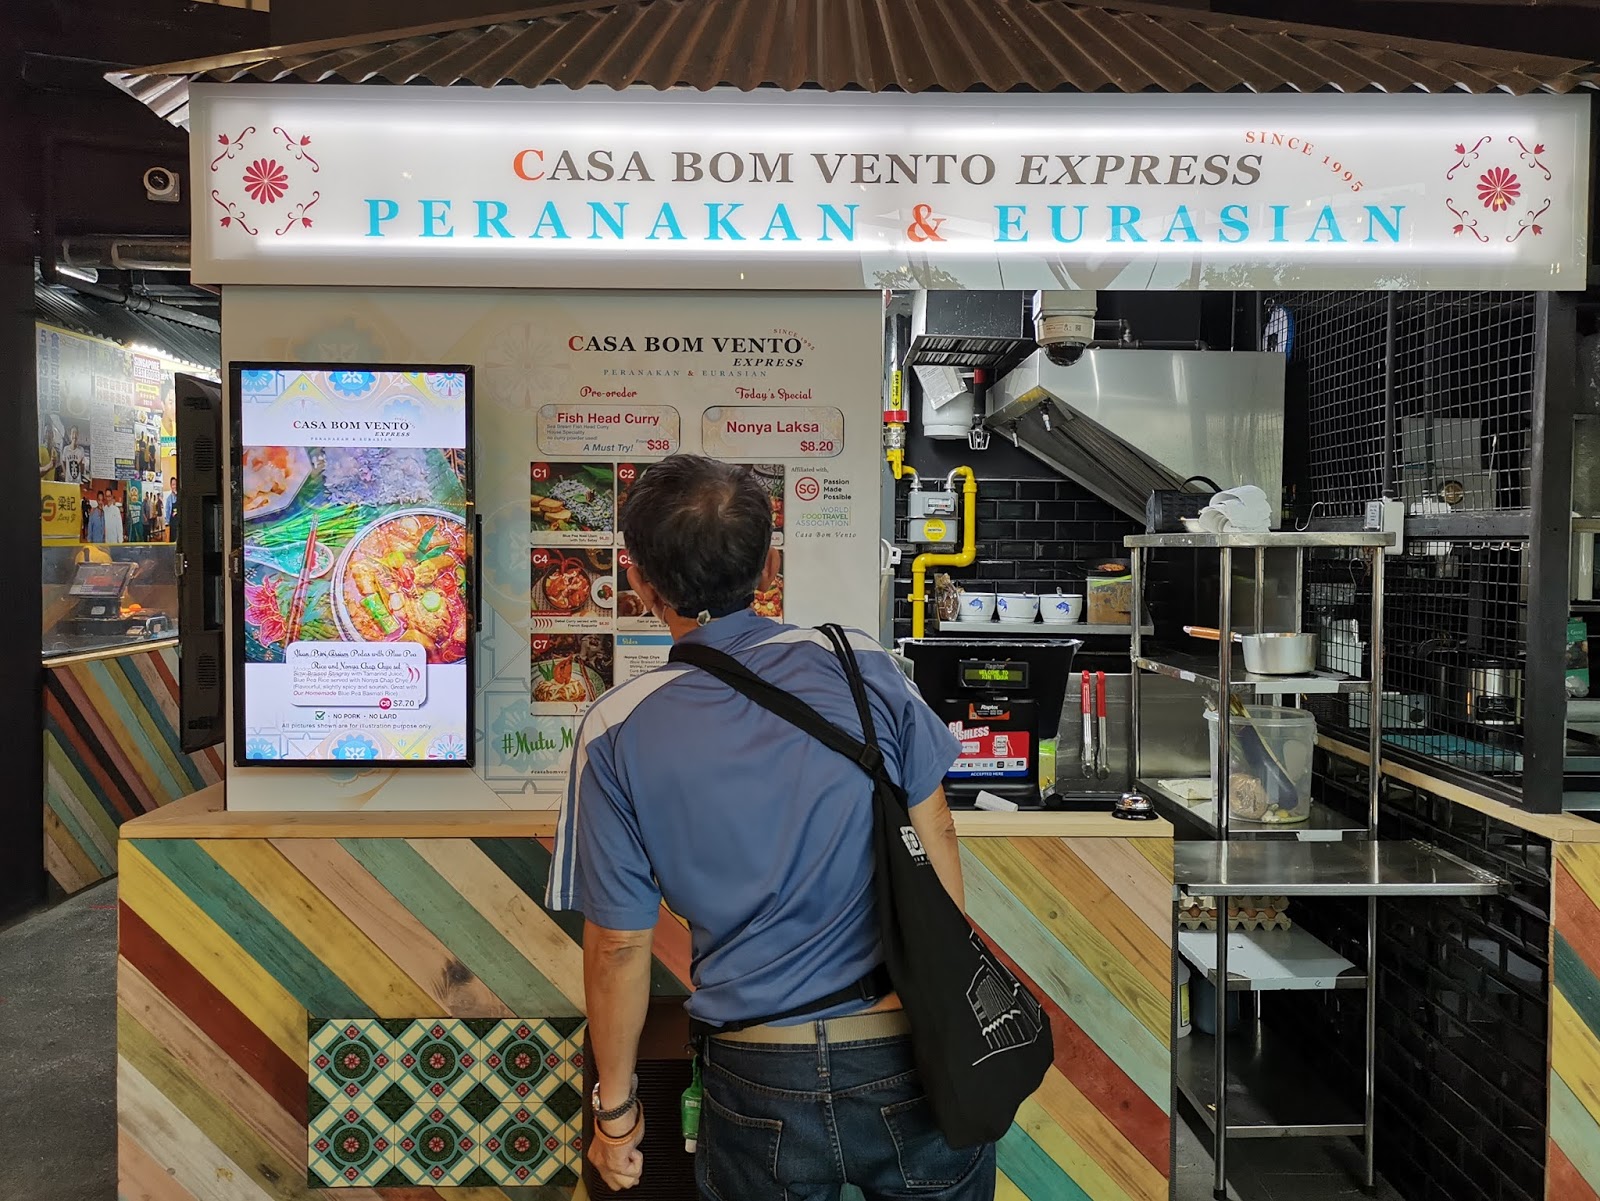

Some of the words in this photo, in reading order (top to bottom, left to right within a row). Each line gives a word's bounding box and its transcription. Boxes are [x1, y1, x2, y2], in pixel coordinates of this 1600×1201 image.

[1244, 129, 1314, 156] SINCE
[1322, 153, 1364, 194] 1995
[512, 149, 655, 182] CASA
[671, 150, 794, 184] BOM
[810, 152, 996, 186] VENTO
[1015, 153, 1264, 187] EXPRESS
[364, 198, 860, 242] PERANAKAN
[906, 203, 948, 243] &
[993, 204, 1406, 243] EURASIAN
[568, 335, 637, 352] CASA
[644, 336, 705, 353] BOM
[711, 337, 802, 354] VENTO
[733, 358, 805, 368] EXPRESS
[134, 366, 146, 378] BEST
[603, 369, 681, 377] PERANAKAN
[687, 369, 694, 378] &
[701, 370, 768, 378] EURASIAN
[735, 386, 775, 401] Today's
[777, 387, 813, 402] Special
[557, 412, 584, 424] Fish
[588, 412, 621, 424] Head
[624, 412, 660, 427] Curry
[293, 420, 327, 429] CASA
[331, 421, 360, 430] BOM
[364, 421, 409, 431] VENTO
[727, 421, 772, 435] Nonya
[777, 421, 819, 433] Laksa
[583, 444, 590, 452] A
[592, 444, 616, 452] Must
[617, 444, 634, 453] Try!
[646, 438, 670, 452] $38
[800, 440, 834, 453] $8.20
[532, 468, 547, 478] C1
[619, 469, 635, 479] C2
[799, 484, 817, 494] SG
[532, 554, 548, 564] C4
[532, 639, 548, 649] C7
[372, 648, 384, 658] with
[402, 648, 417, 658] Pea
[311, 661, 327, 670] Rice
[328, 661, 339, 670] and
[339, 661, 359, 671] Nonya
[360, 661, 376, 671] Chap
[377, 661, 393, 671] Chye
[948, 721, 963, 731] GO
[954, 726, 990, 741] ASHLESS
[502, 730, 557, 758] #Mutu
